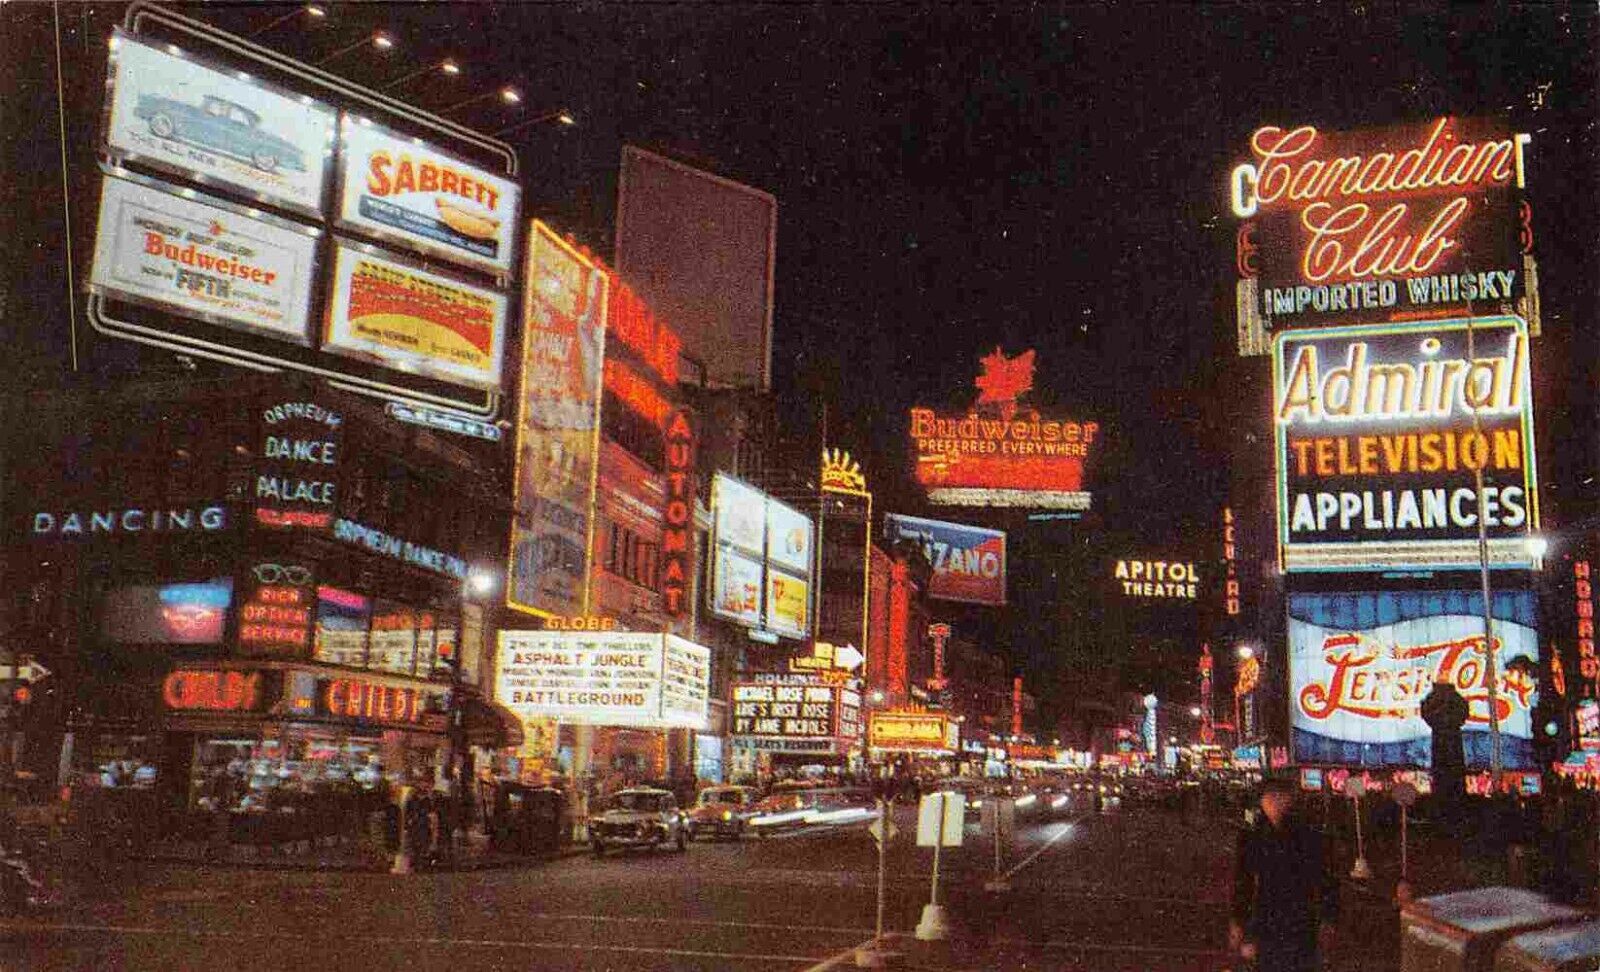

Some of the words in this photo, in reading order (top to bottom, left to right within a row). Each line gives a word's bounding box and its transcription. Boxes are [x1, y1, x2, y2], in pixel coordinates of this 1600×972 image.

[1251, 116, 1514, 203] Canadian
[367, 151, 499, 211] SABRETT
[1303, 197, 1468, 281] Club
[144, 232, 276, 285] Budweiser
[1264, 280, 1397, 316] IMPORTED
[1407, 269, 1516, 306] WHISKY
[1276, 331, 1525, 424] Admiral
[910, 406, 1099, 443] Budweiser
[264, 436, 336, 464] DANCE
[918, 437, 997, 454] PREFERRED
[1002, 440, 1088, 457] EVERYWHERE
[1290, 428, 1520, 477] TELEVISION
[256, 474, 336, 504] PALACE
[34, 507, 226, 533] DANCING
[665, 412, 692, 612] AUTOMAT
[1291, 485, 1526, 531] APPLIANCES
[1123, 580, 1196, 599] THEATRE
[546, 616, 616, 630] GLOBE
[513, 652, 584, 666] ASPHALT
[590, 654, 647, 668] JUNGLE
[513, 691, 646, 707] BATTLEGROUND
[802, 703, 829, 718] ROSE
